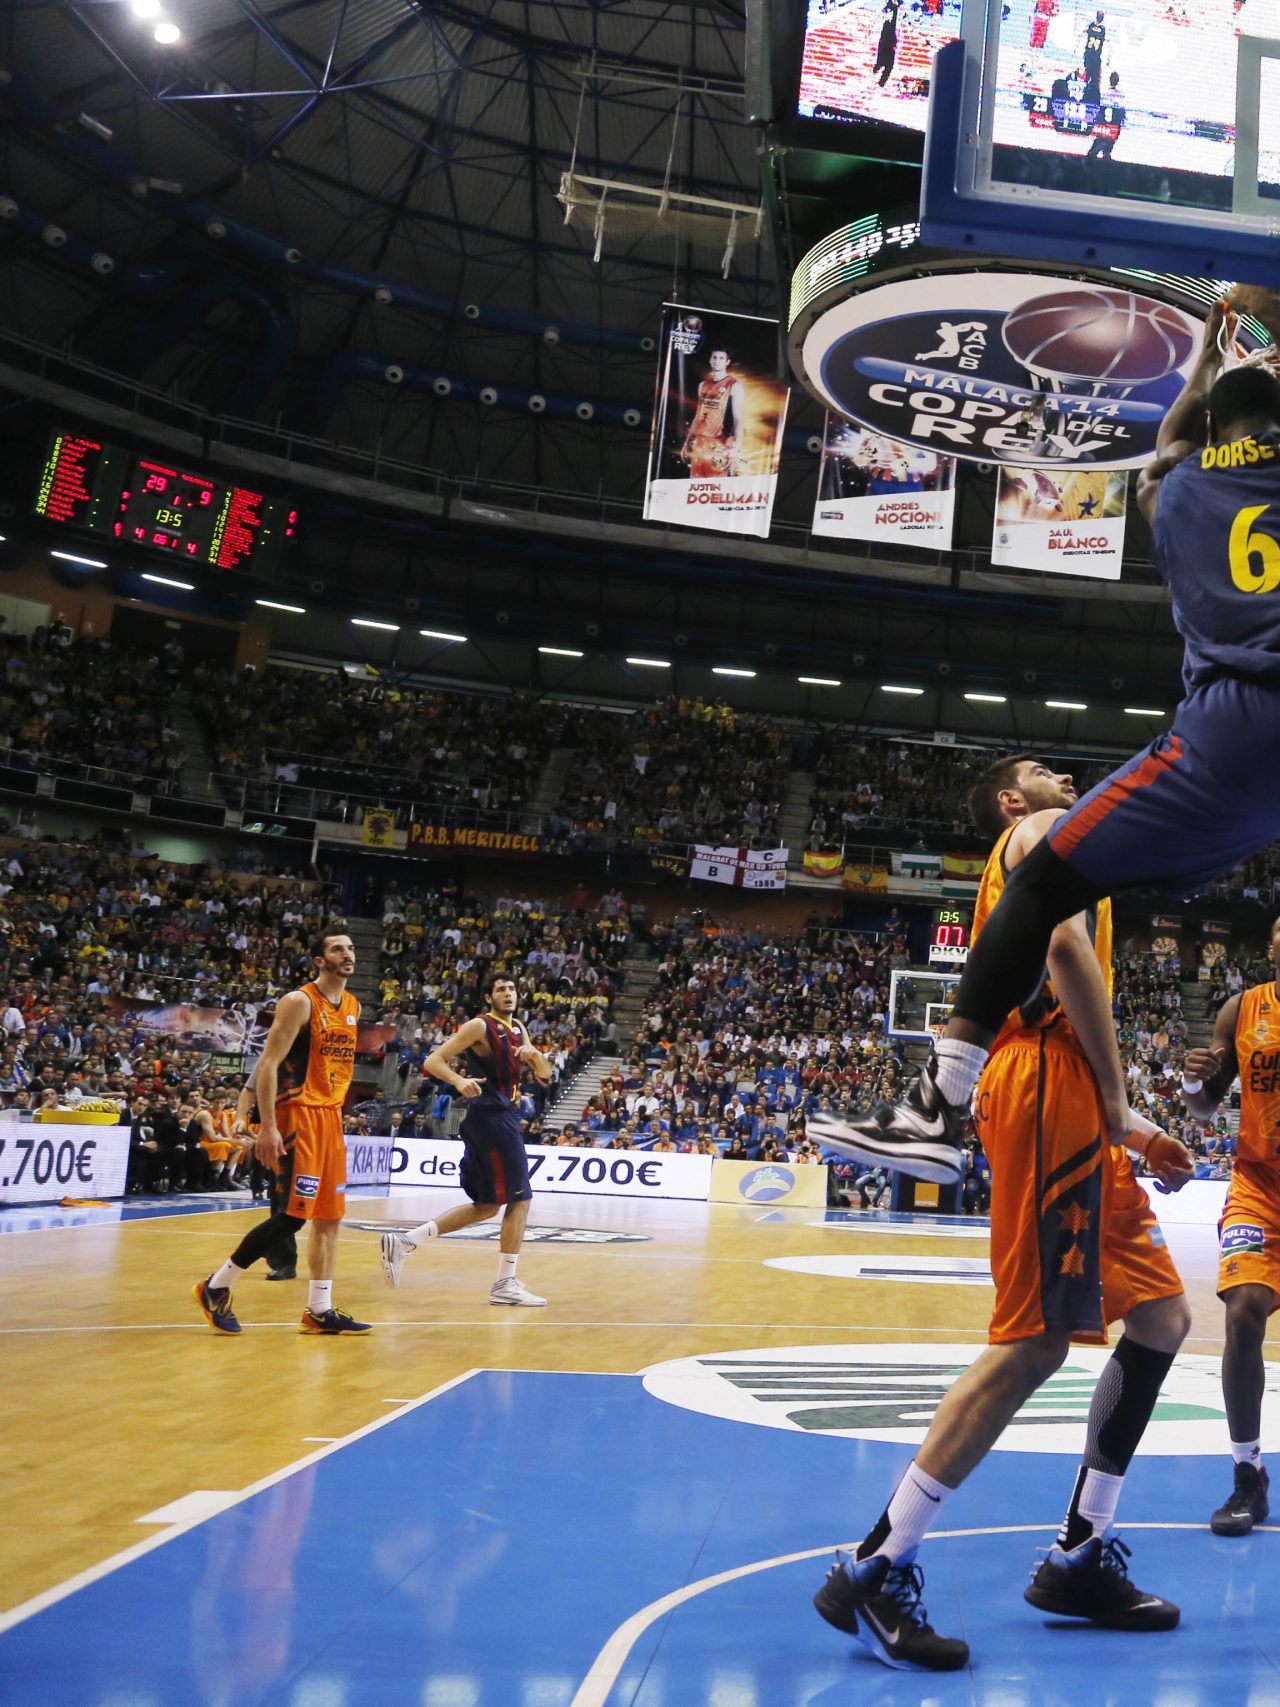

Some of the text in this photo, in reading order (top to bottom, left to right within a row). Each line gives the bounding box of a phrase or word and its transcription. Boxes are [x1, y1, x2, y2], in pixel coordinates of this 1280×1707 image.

[674, 342, 696, 352] REY
[869, 383, 1130, 438] COPA DEL
[911, 413, 1111, 459] REY
[146, 474, 167, 492] 29
[200, 490, 213, 506] 9
[689, 483, 720, 491] JUSTIN
[687, 493, 769, 504] DOELLMAN
[877, 502, 919, 511] ANDRÉS
[156, 509, 183, 527] 13:5
[1049, 528, 1073, 537] SAÚL
[135, 527, 146, 539] 4
[187, 542, 198, 554] 4
[1048, 537, 1108, 550] BLANCO
[411, 824, 449, 846] P.B.B.
[453, 828, 540, 852] MERITXELL
[763, 852, 774, 861] C
[708, 866, 718, 877] B
[940, 911, 959, 923] 13:5
[936, 926, 963, 946] 07
[931, 946, 967, 956] DKV
[0, 1139, 97, 1187] .700€
[352, 1145, 373, 1174] KIA
[1222, 1228, 1262, 1242] PULEVA
